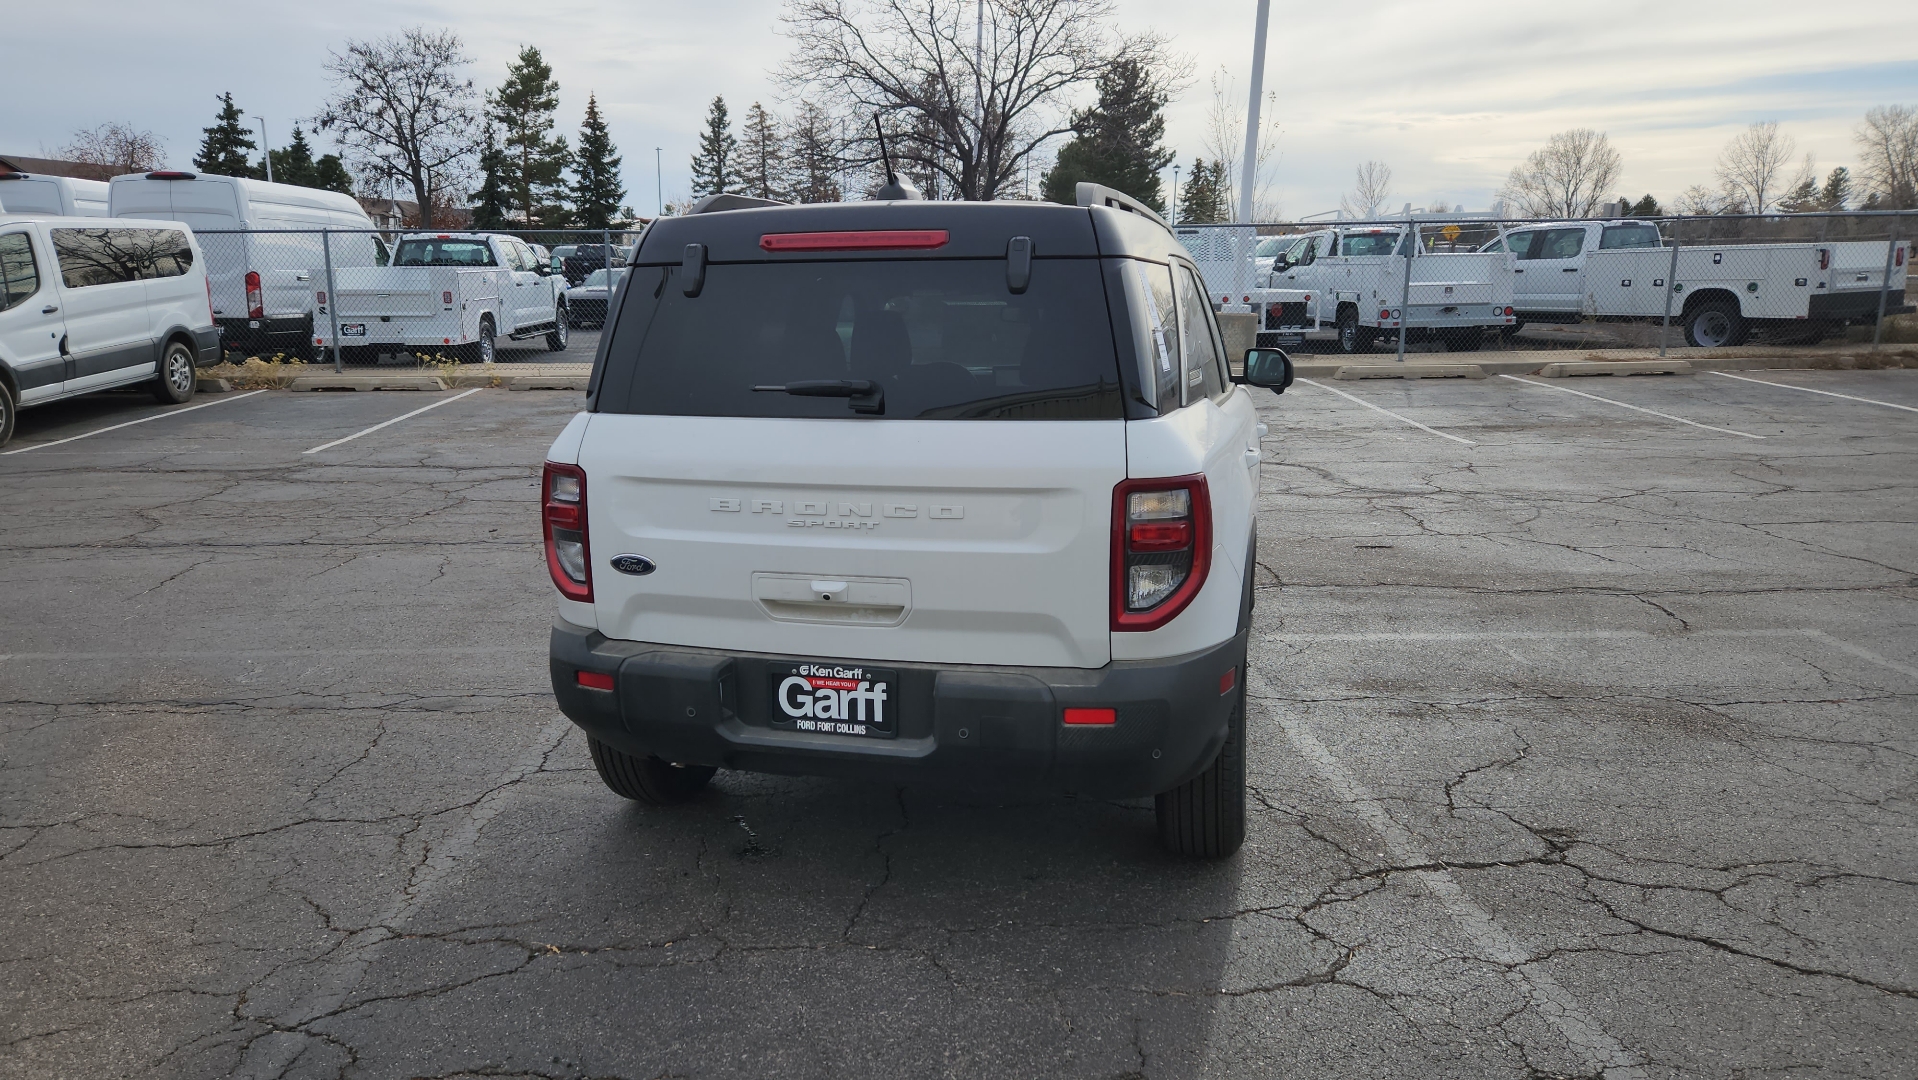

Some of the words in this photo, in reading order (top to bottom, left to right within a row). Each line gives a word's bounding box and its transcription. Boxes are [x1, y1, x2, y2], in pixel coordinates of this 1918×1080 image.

[709, 497, 965, 519] BRONCO
[787, 518, 880, 529] SPORT
[619, 557, 644, 571] Ford
[810, 665, 832, 677] Ken
[834, 667, 862, 679] Garff
[779, 676, 887, 722] Garff
[797, 720, 815, 730] FORD
[817, 722, 835, 732] FORT
[837, 723, 866, 735] COLLINS
